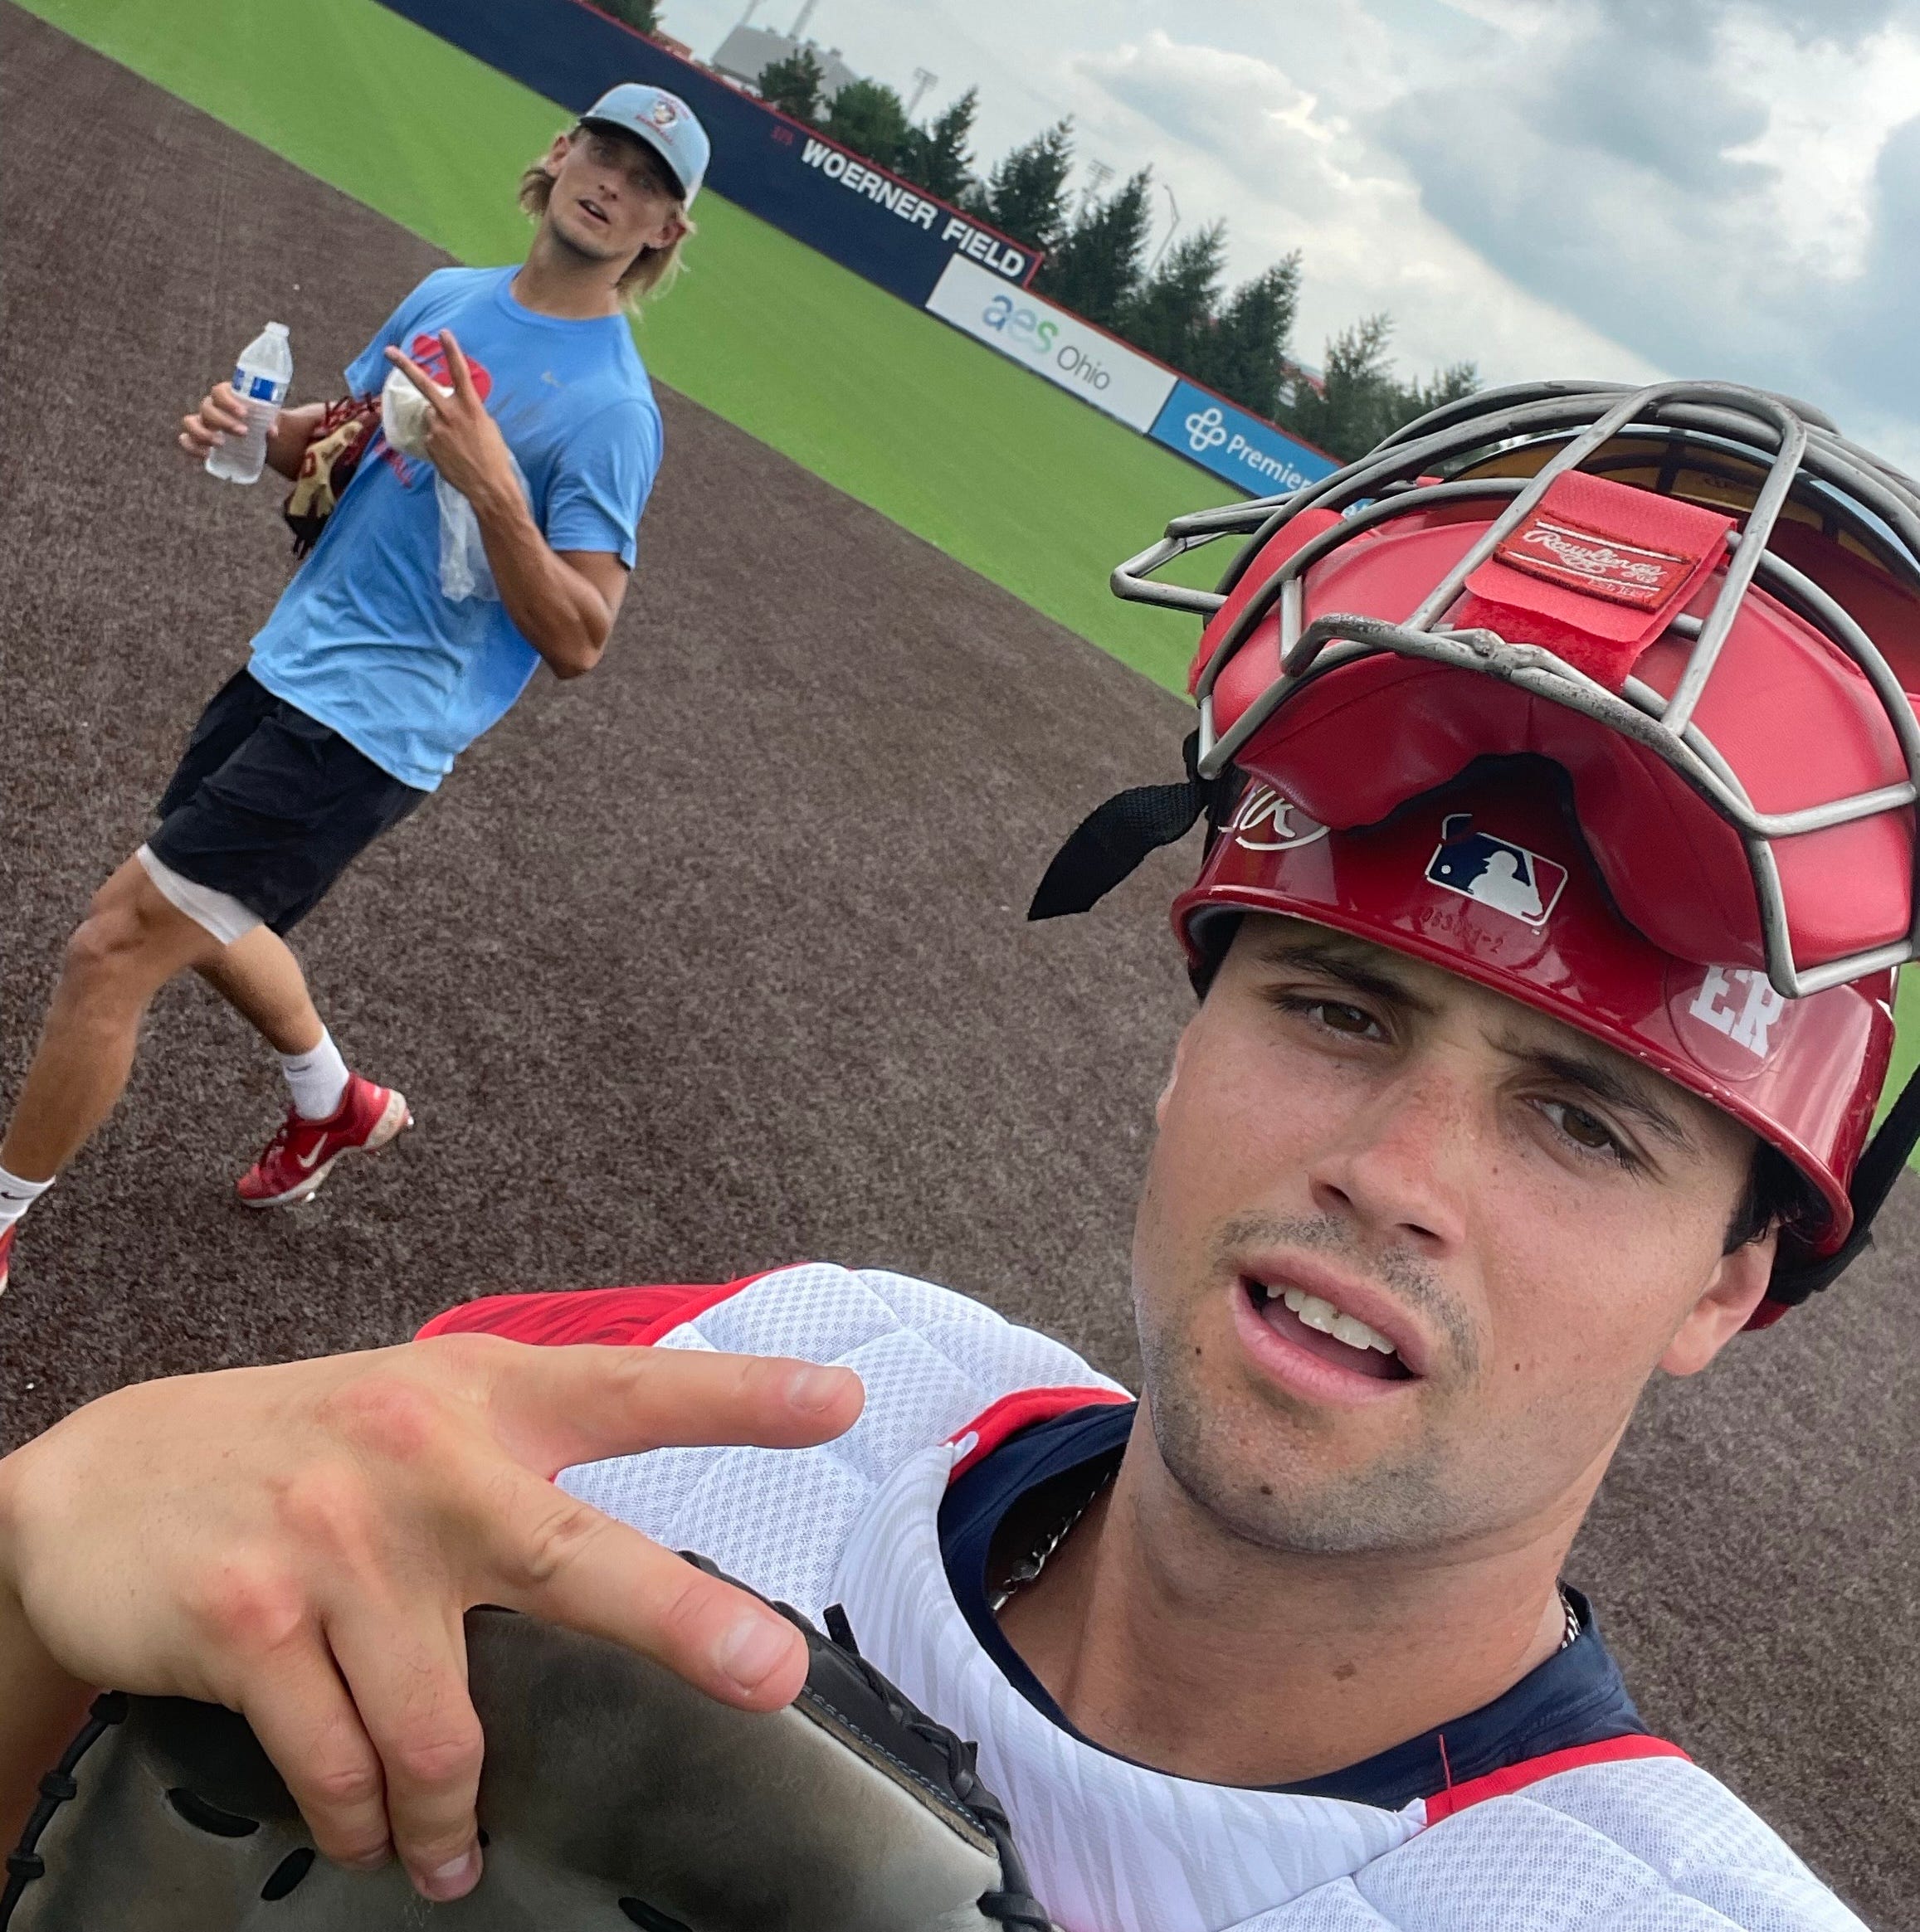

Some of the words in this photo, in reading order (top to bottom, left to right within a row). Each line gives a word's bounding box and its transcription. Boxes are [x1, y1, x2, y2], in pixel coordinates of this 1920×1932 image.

[801, 138, 939, 230] WOERNER
[941, 217, 1026, 278] FIELD
[982, 294, 1060, 355] aes
[1056, 345, 1111, 391] Ohio
[1225, 433, 1313, 491] Premier
[1523, 530, 1668, 584] Rawlings
